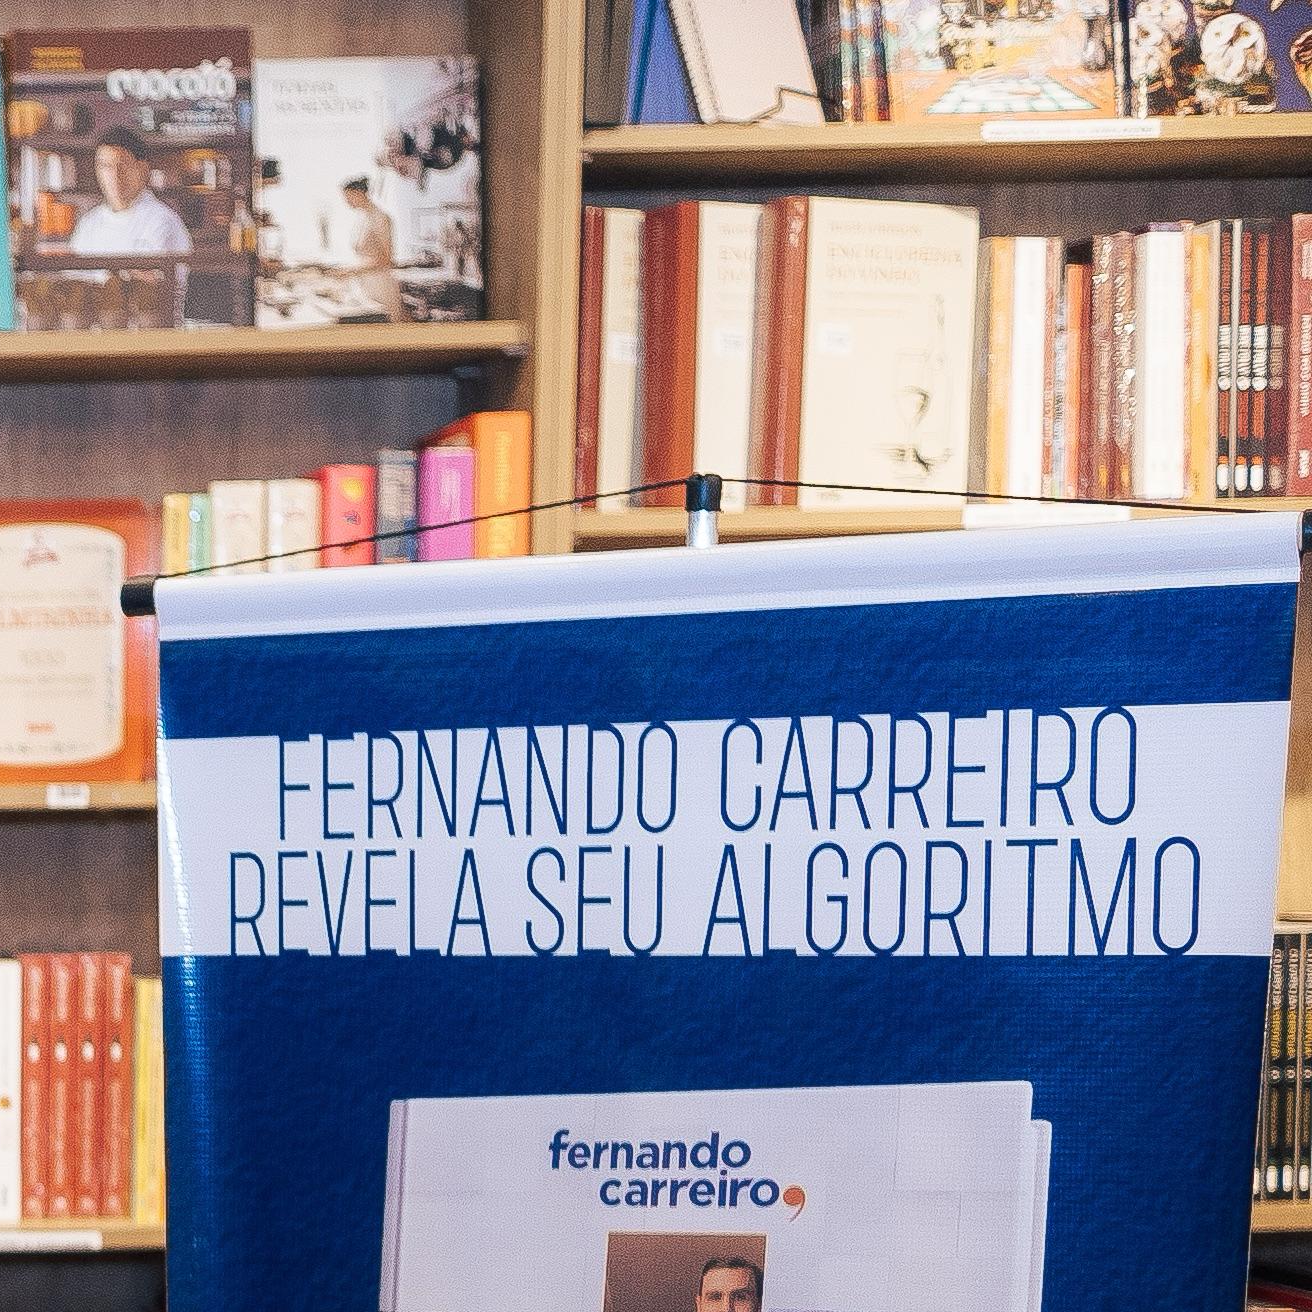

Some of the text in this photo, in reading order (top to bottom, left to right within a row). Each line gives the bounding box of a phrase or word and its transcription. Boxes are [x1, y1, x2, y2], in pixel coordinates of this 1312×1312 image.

[278, 704, 1137, 840] FERNANDO CARREIRO
[230, 835, 1201, 957] REVELA SEU ALGORITMO
[549, 1129, 752, 1170] fernando
